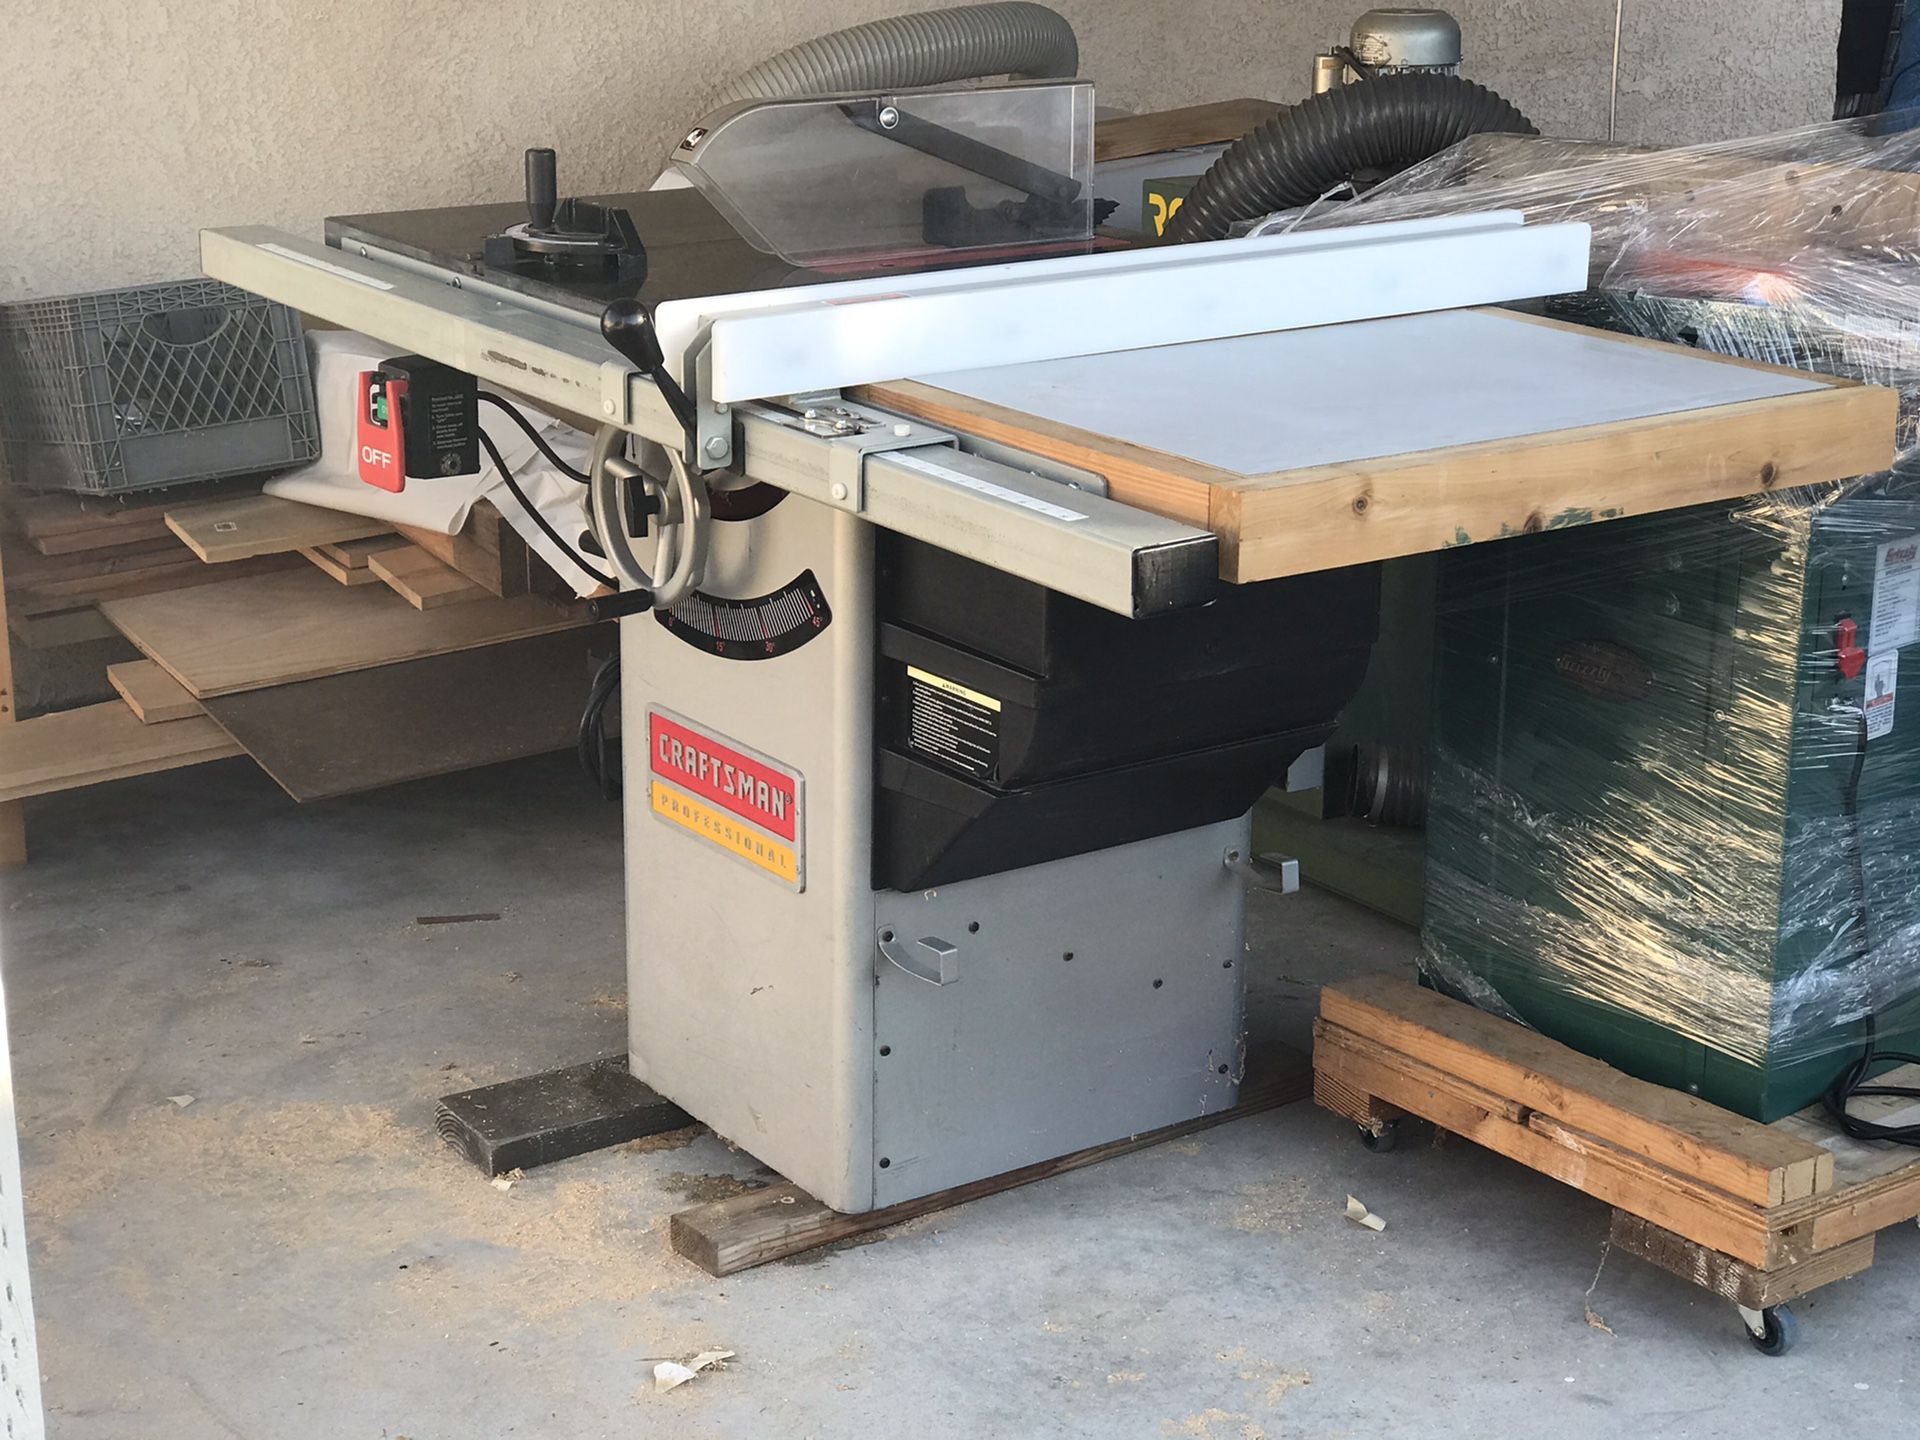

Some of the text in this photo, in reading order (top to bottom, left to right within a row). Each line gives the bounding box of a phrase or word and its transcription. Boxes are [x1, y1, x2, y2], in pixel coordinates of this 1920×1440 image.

[361, 445, 392, 469] OFF
[659, 733, 787, 821] CRAFTSMAN
[661, 794, 787, 869] PROFESSIONAL
